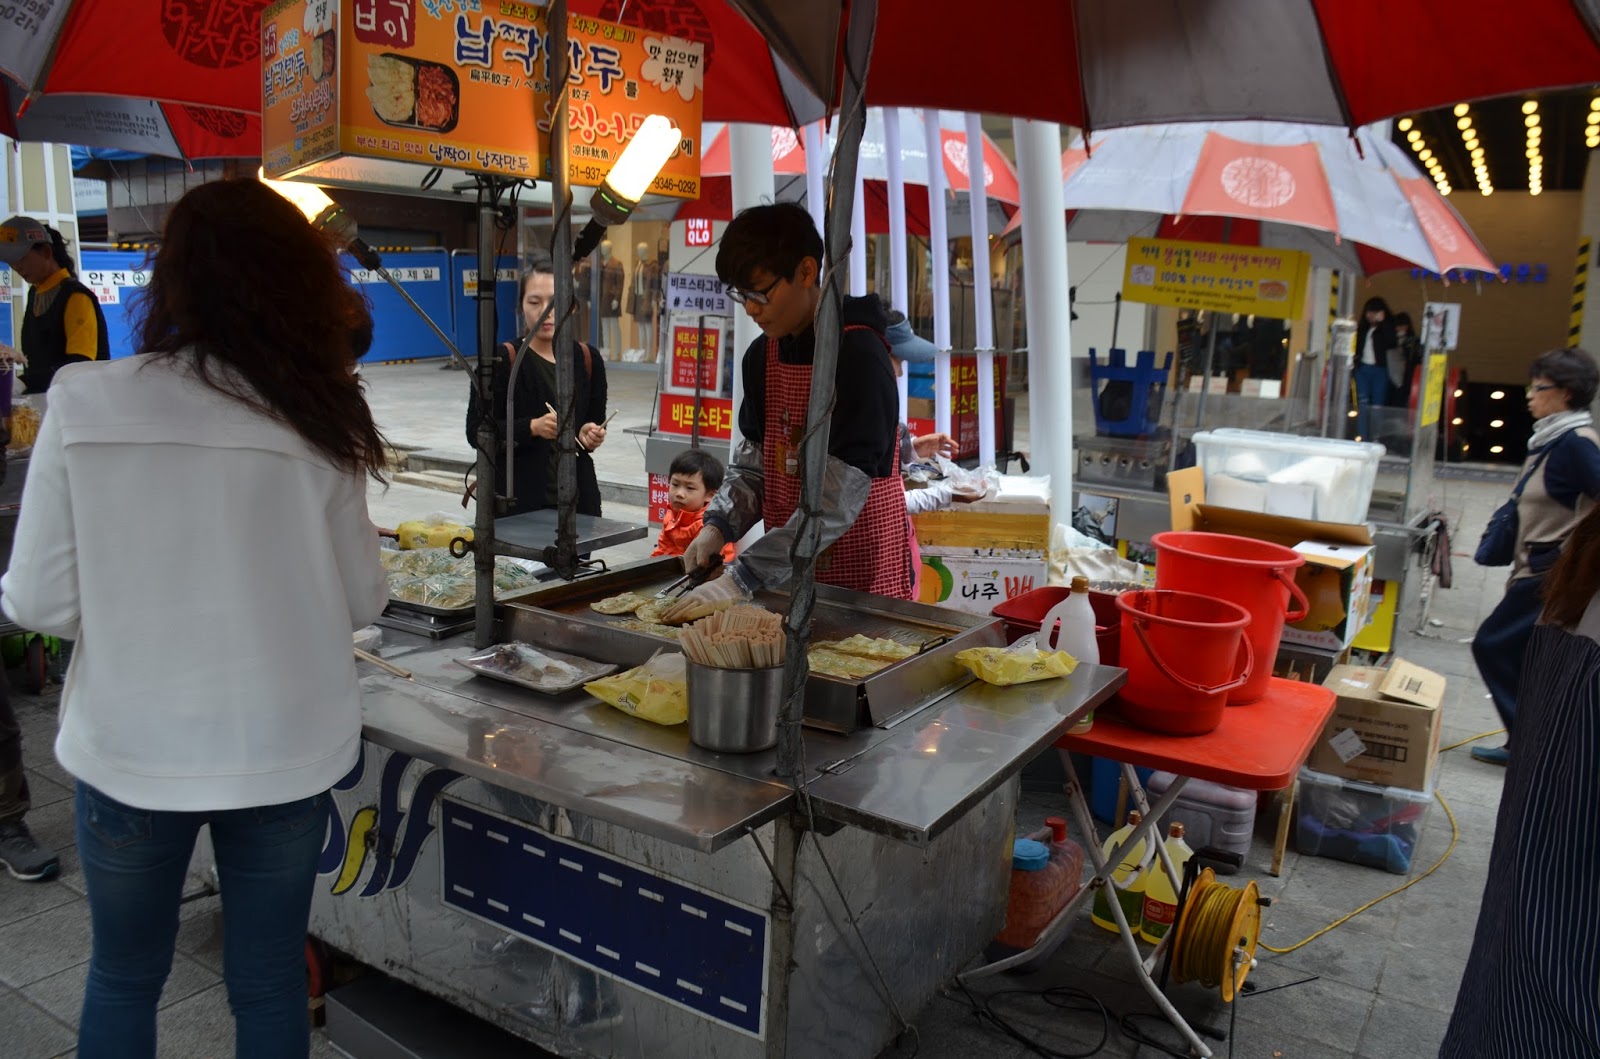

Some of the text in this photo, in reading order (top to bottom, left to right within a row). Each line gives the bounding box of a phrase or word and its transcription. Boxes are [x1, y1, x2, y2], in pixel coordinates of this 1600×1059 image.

[650, 45, 699, 69] 맛 없으면
[381, 138, 401, 151] 최고
[688, 230, 710, 245] QLO
[671, 276, 723, 294] 비프스타그램
[684, 296, 725, 311] 스테이크
[677, 331, 717, 347] 비프스그램
[672, 402, 732, 432] 비프스타그
[961, 582, 999, 601] 나주
